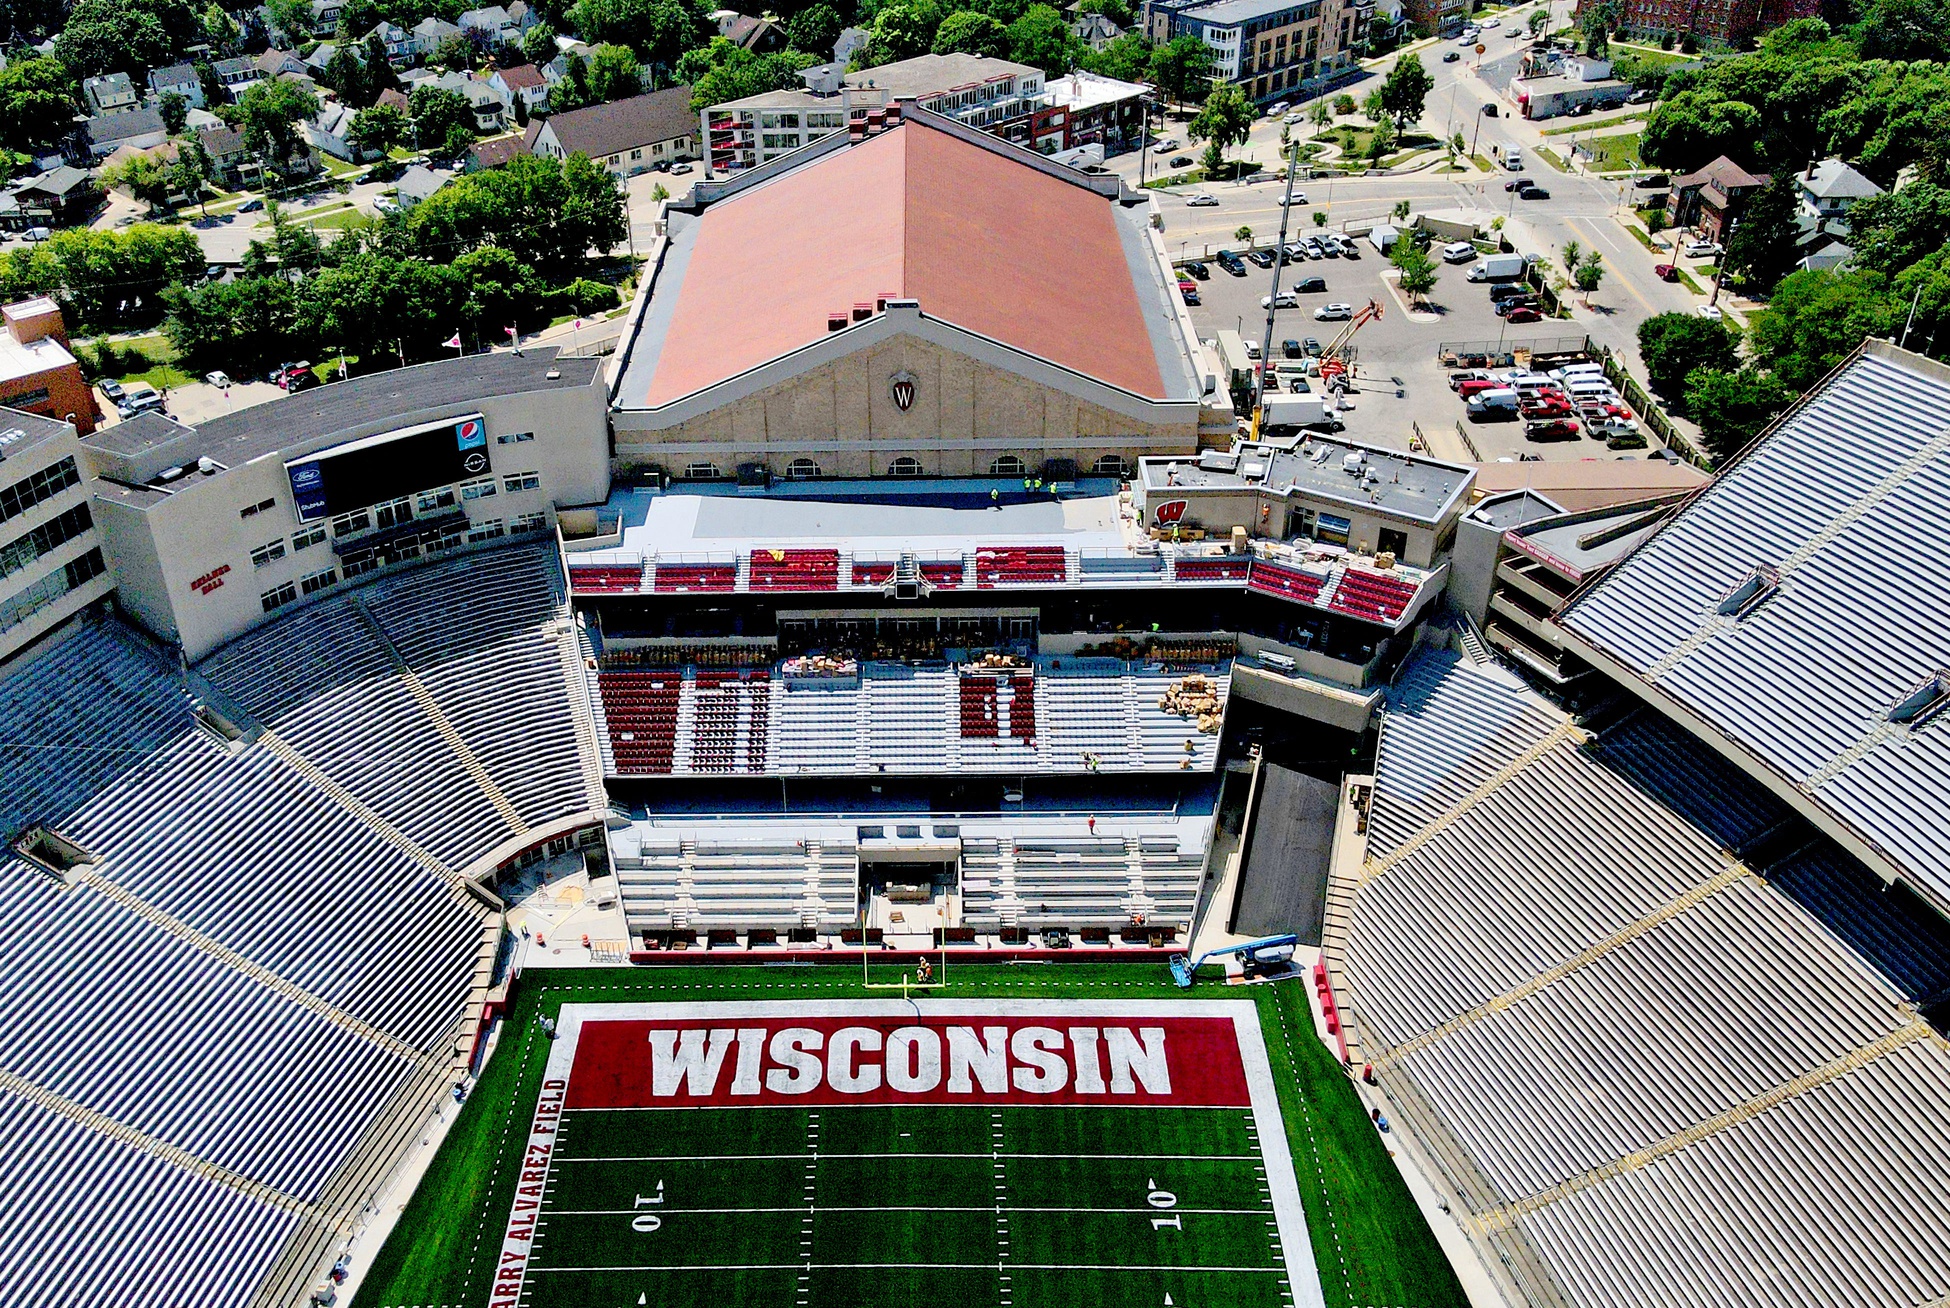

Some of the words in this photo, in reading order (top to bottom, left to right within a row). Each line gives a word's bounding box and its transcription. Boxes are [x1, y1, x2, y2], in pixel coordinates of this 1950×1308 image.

[895, 386, 912, 407] W
[1155, 500, 1188, 527] W
[648, 1028, 1172, 1096] WISCONSIN
[508, 1144, 551, 1241] ALVAREZ
[533, 1079, 566, 1135] FIELD
[1147, 1191, 1182, 1231] 10
